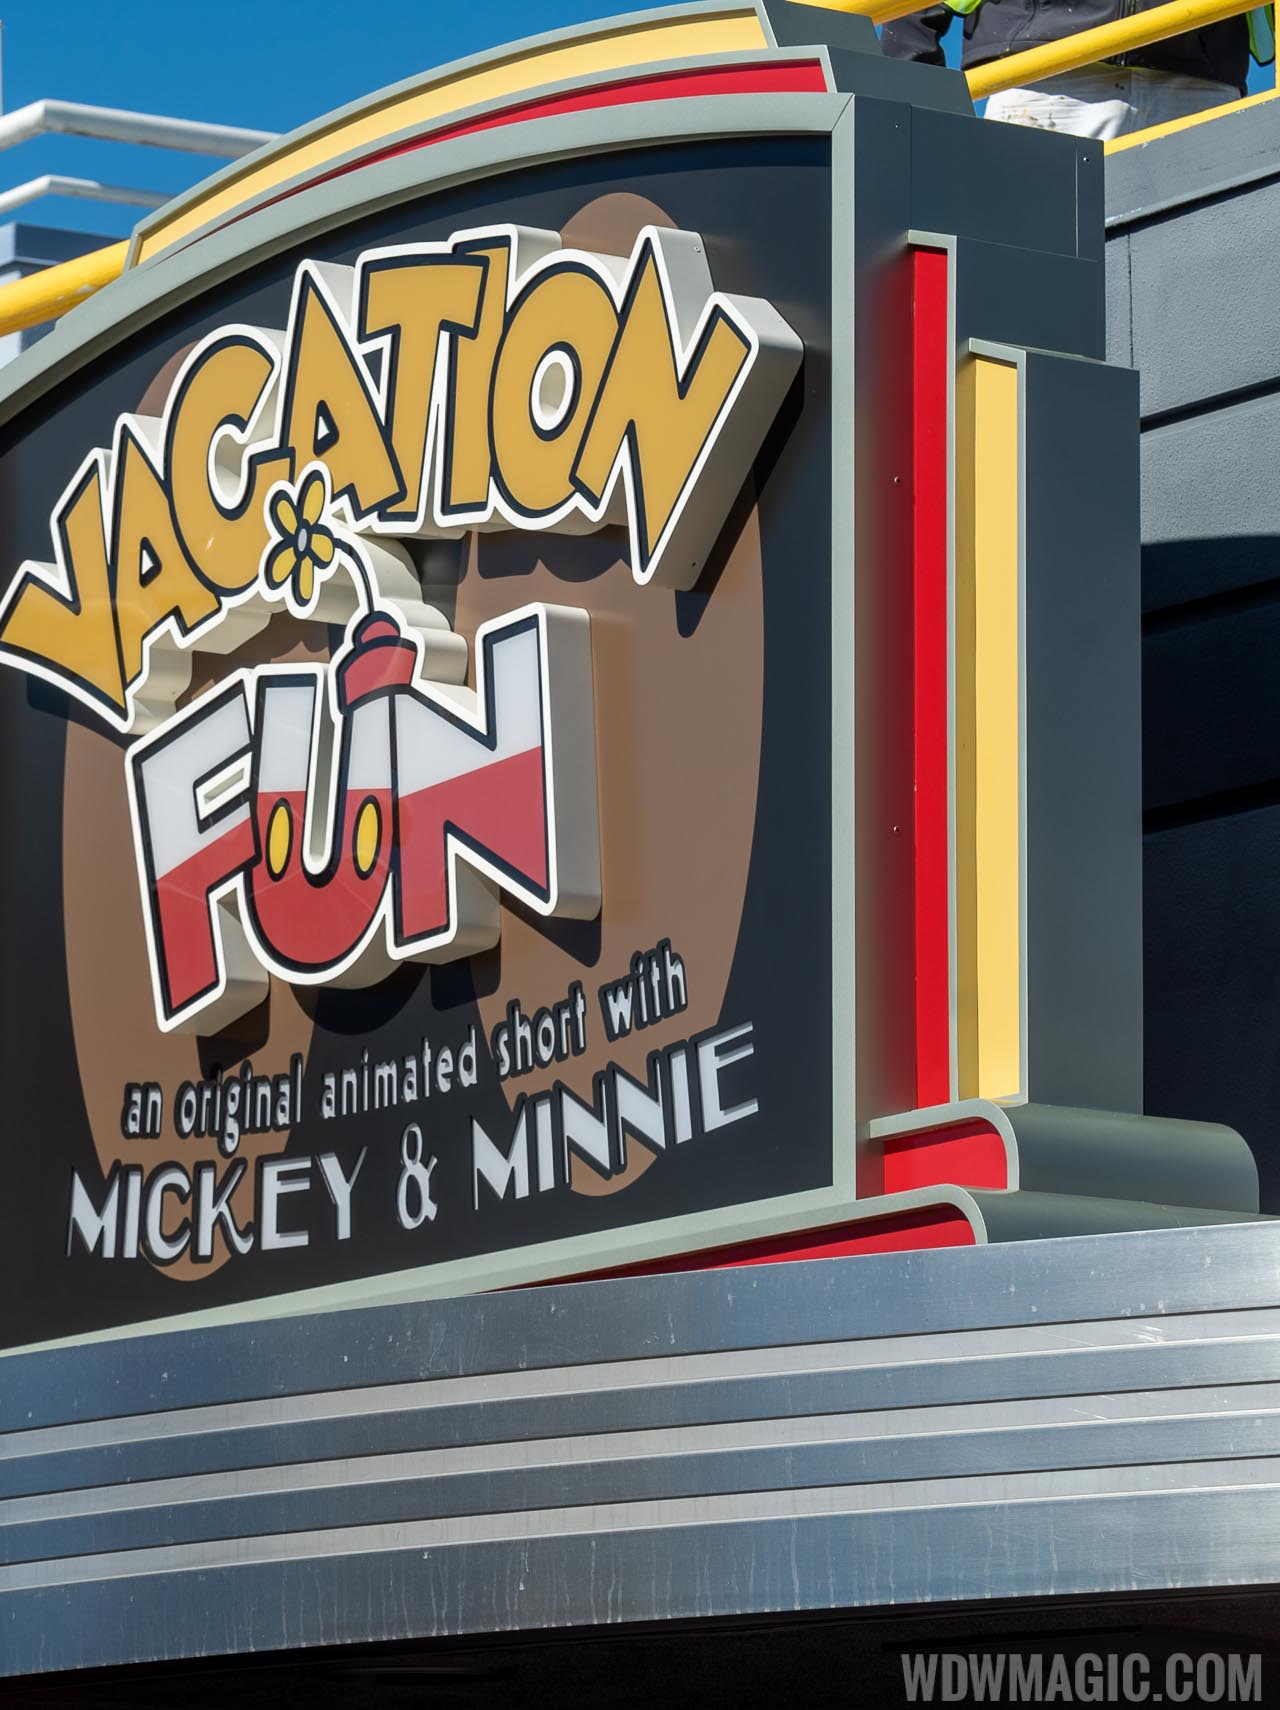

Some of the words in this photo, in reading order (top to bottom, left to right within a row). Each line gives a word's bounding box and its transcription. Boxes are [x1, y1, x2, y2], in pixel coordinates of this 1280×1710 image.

[128, 606, 556, 1028] FUN
[67, 1146, 368, 1260] MICKEY
[396, 1124, 438, 1230] &
[471, 1021, 759, 1210] MINNIE
[124, 1083, 162, 1136] an
[180, 1057, 304, 1151] original
[321, 1034, 478, 1119] animated
[498, 983, 587, 1076] short
[606, 942, 689, 1034] with
